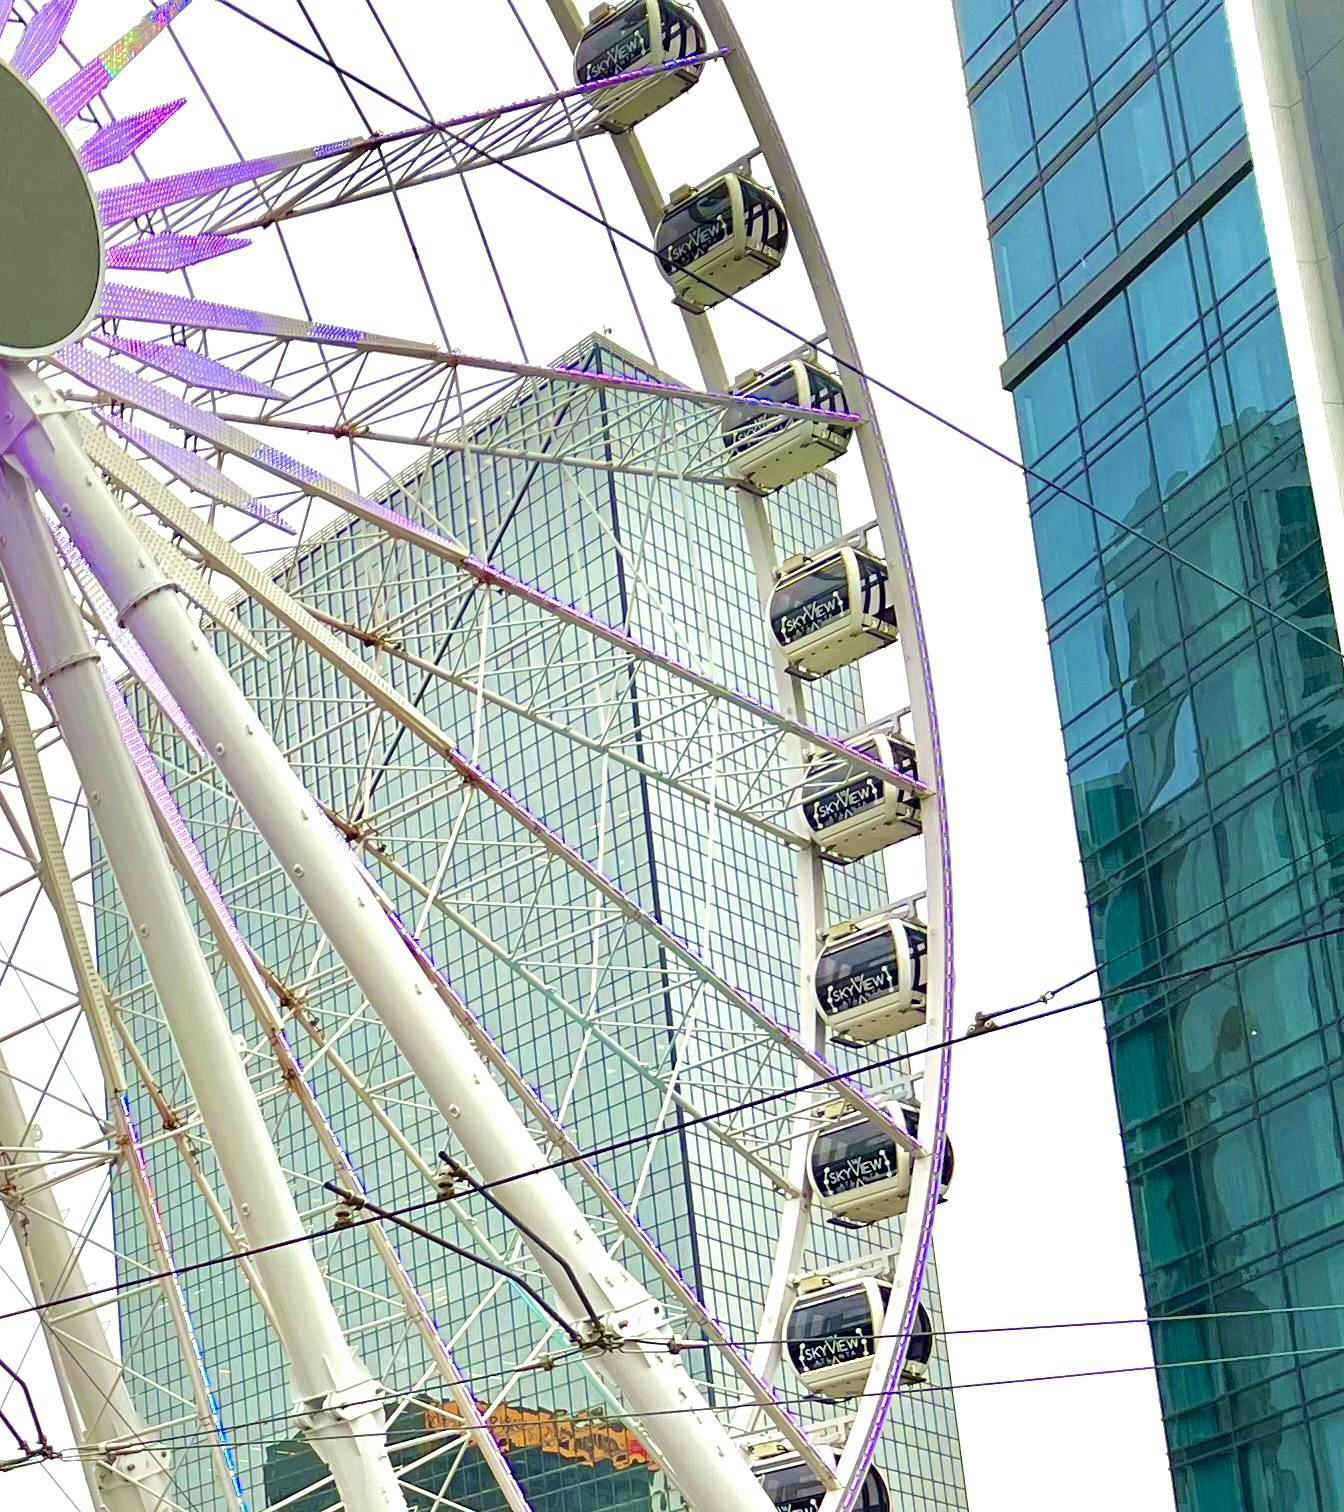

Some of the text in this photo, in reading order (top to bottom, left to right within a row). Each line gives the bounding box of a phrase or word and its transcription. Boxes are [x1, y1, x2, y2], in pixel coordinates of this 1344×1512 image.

[672, 222, 720, 260] SKYVIEW
[786, 598, 836, 632] SKYVIEW
[819, 786, 870, 818] SKYVIEW
[832, 973, 885, 1002] SKYVIEW
[829, 1156, 882, 1185] SKYVIEW
[805, 1333, 859, 1361] SKYVIEW
